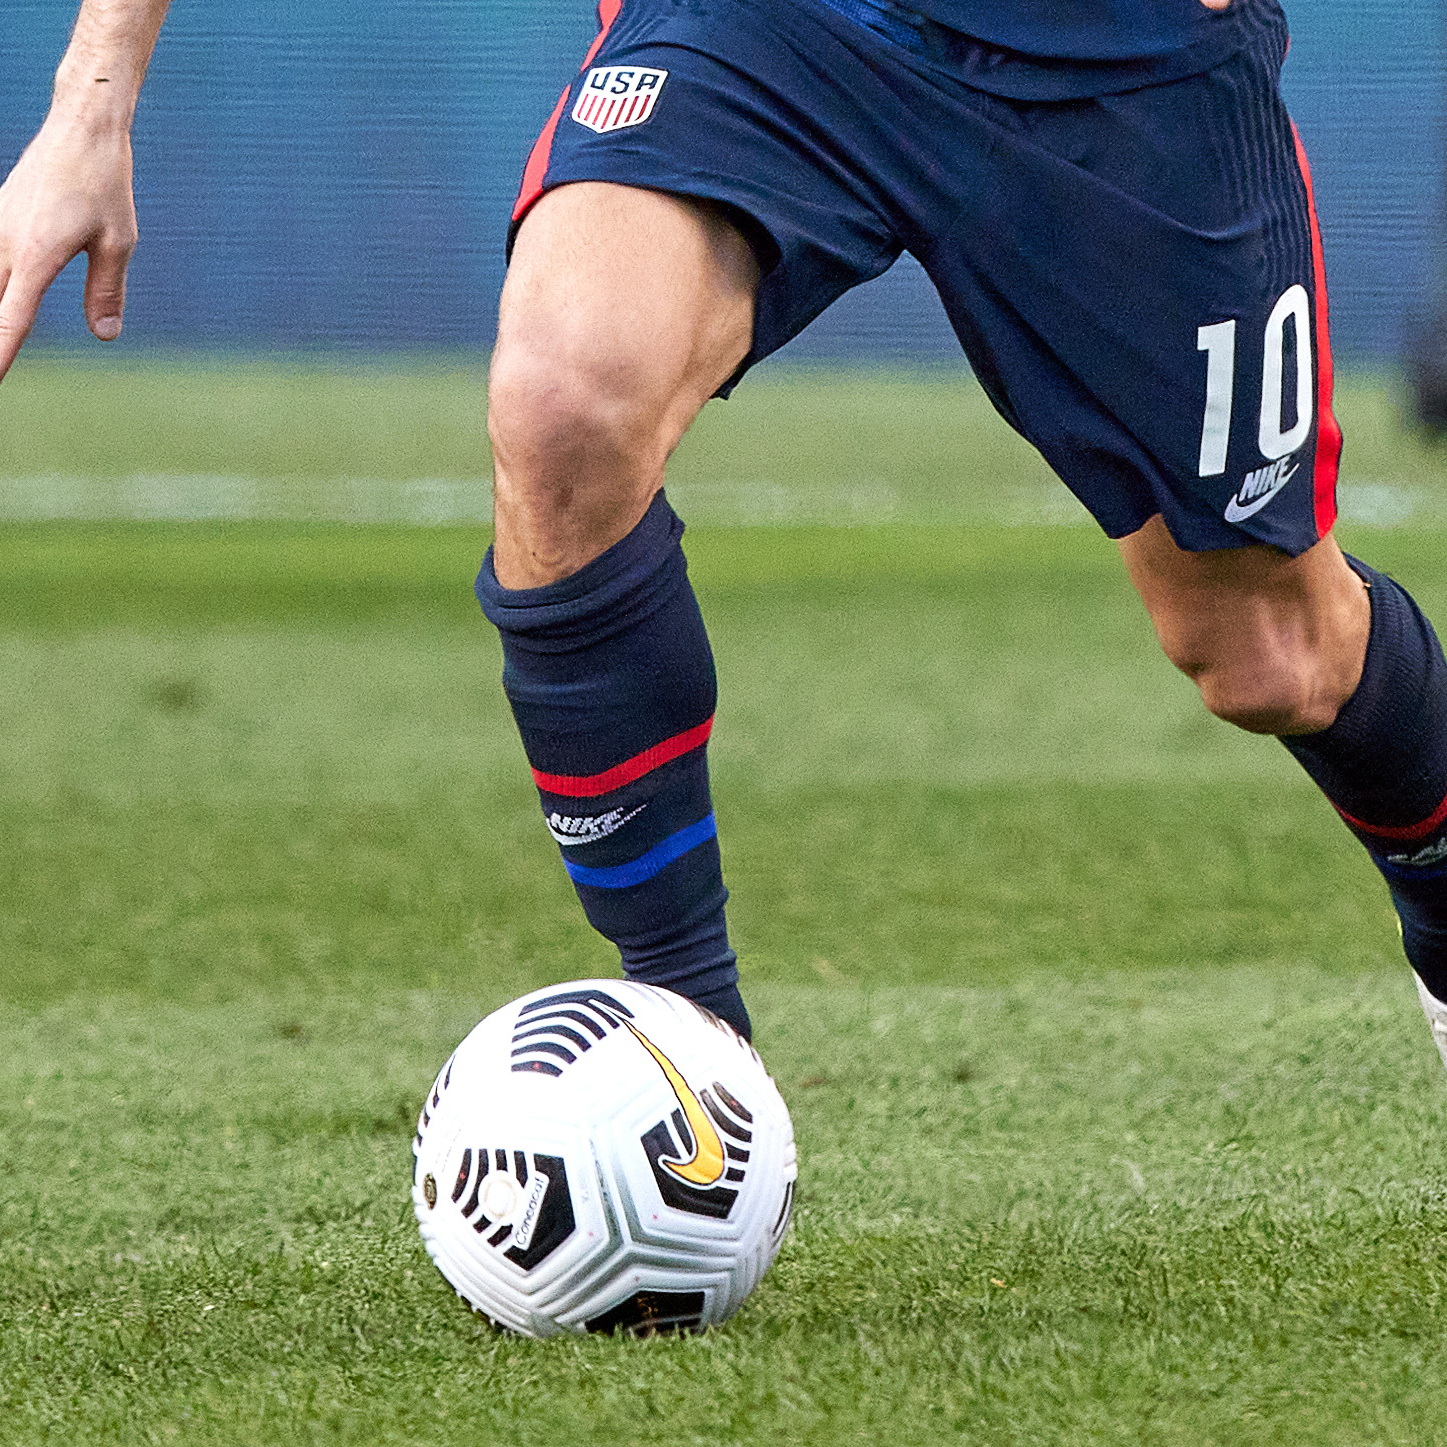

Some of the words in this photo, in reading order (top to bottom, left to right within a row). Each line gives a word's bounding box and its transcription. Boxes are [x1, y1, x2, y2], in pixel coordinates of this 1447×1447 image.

[590, 71, 660, 94] USA
[1197, 284, 1313, 478] 10
[1238, 455, 1292, 502] NIKE
[550, 807, 624, 834] NIKE
[515, 1176, 545, 1245] Concacaf
